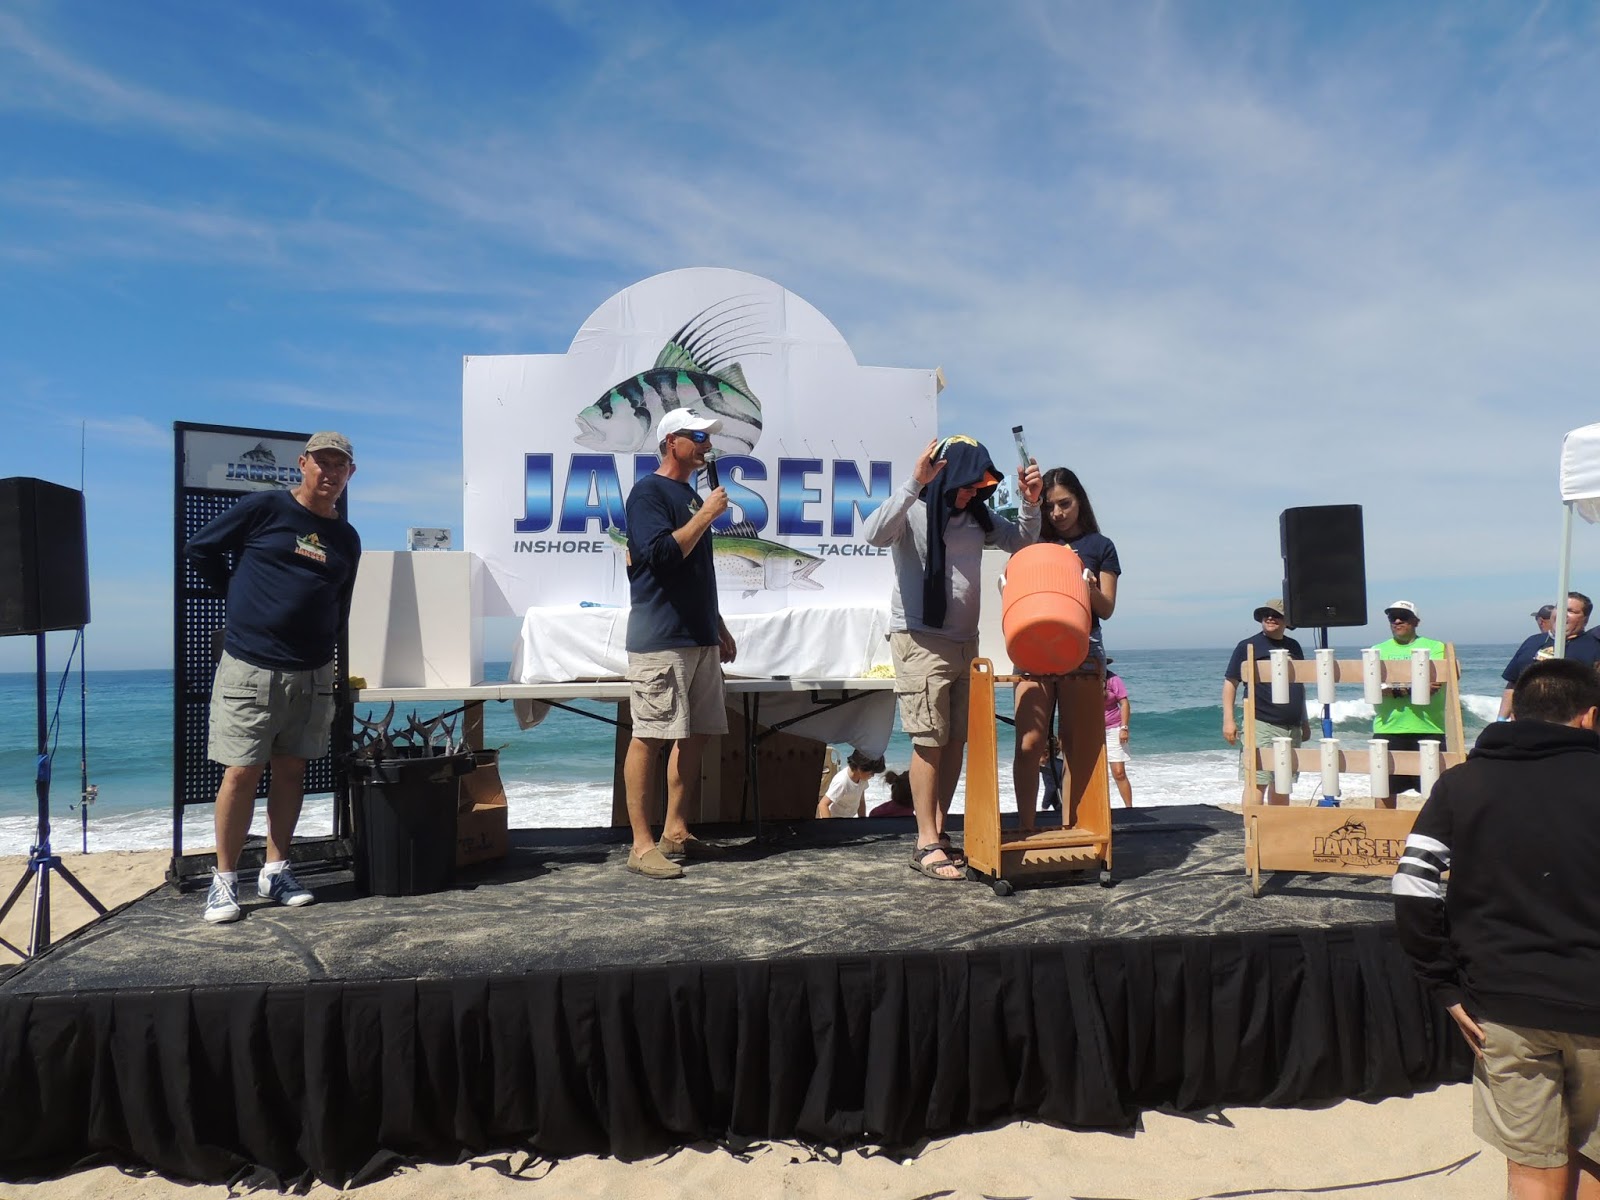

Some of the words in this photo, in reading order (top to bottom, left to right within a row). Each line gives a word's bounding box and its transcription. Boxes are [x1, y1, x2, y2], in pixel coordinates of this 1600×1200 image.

[225, 463, 302, 482] JANSEN
[514, 453, 892, 537] JASEN
[513, 540, 605, 553] INSHORE
[817, 543, 888, 556] TACKLE
[1313, 837, 1406, 858] JANSEN
